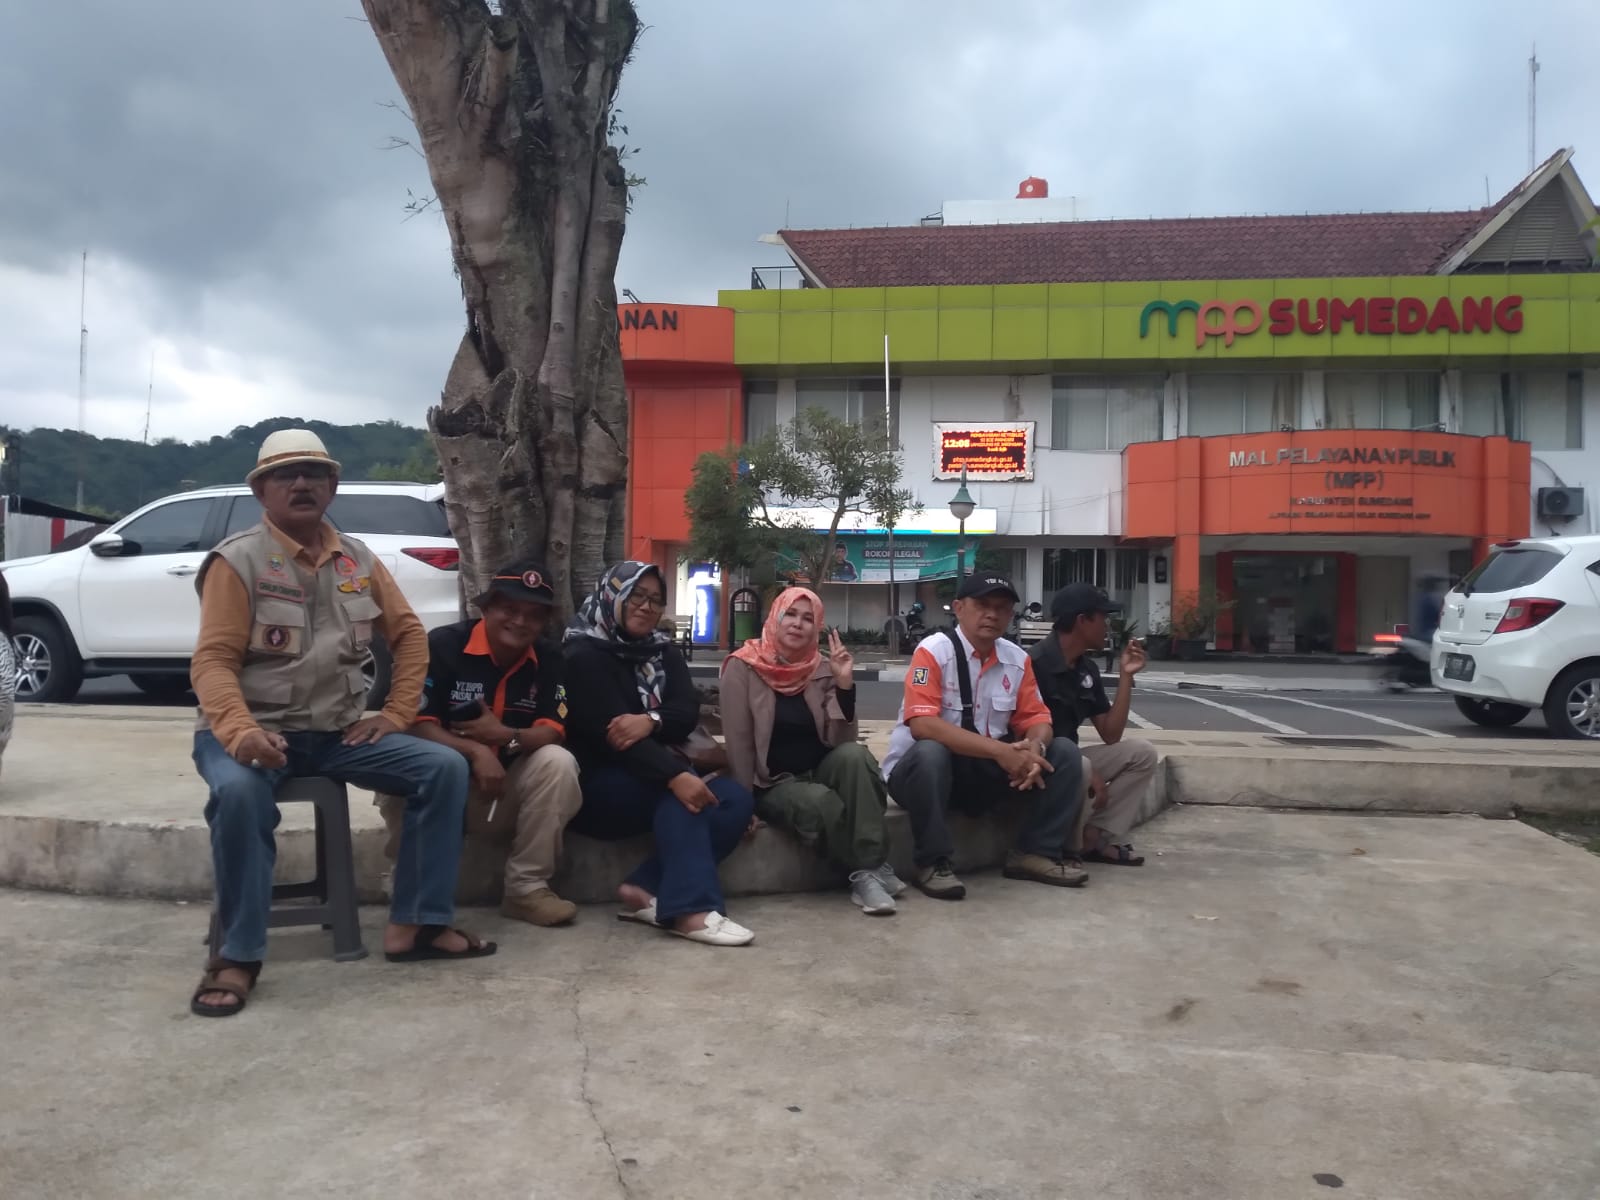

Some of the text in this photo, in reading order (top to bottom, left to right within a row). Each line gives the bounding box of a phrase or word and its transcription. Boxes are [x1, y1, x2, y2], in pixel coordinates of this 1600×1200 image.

[618, 309, 678, 331] NAN
[1139, 296, 1524, 349] mpp SUMEDANG
[1229, 448, 1456, 468] MAL PELAYANAN PUBLIK
[1324, 470, 1385, 490] (MPP)
